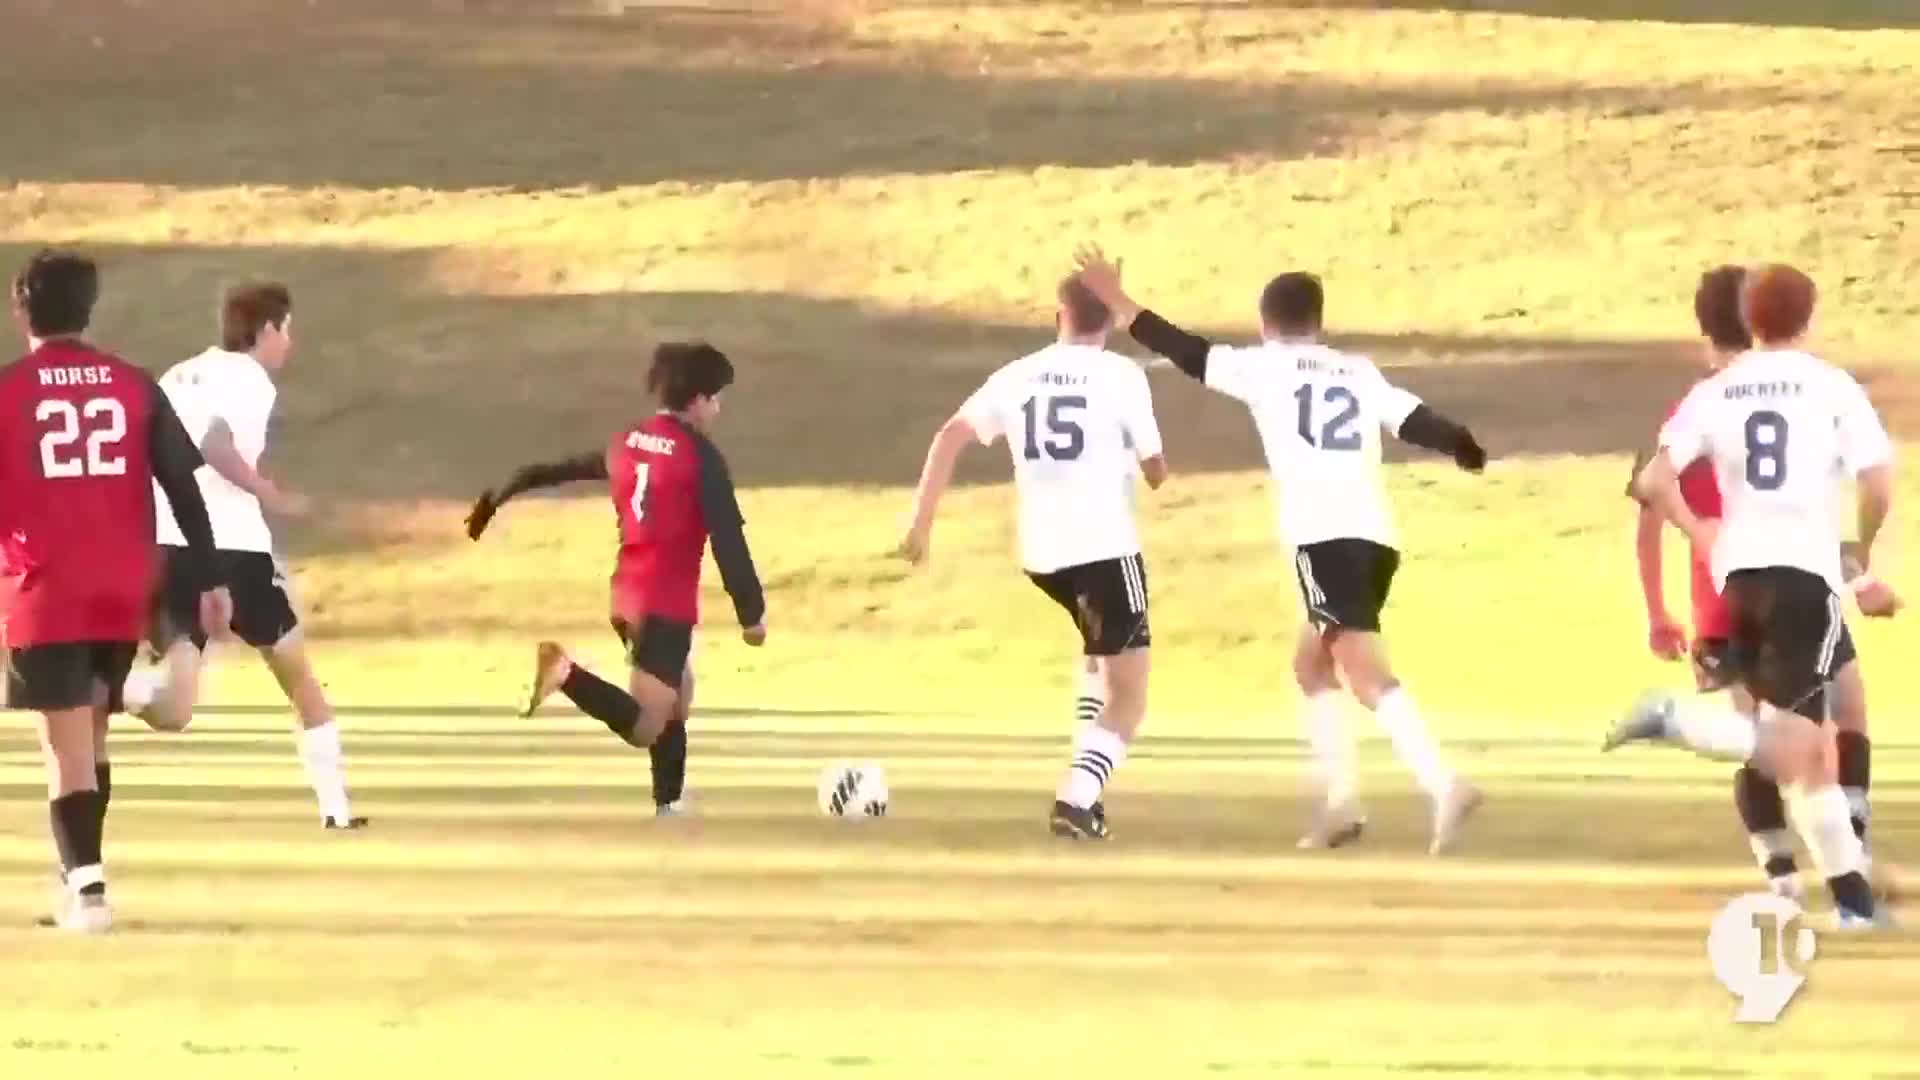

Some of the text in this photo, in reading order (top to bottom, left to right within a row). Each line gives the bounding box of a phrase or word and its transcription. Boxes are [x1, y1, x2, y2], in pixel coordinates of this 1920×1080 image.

[37, 366, 113, 385] NORSE
[36, 398, 126, 478] 22
[1021, 395, 1087, 461] 15
[1293, 382, 1362, 451] 12
[1743, 410, 1788, 491] 8
[630, 463, 649, 523] 1
